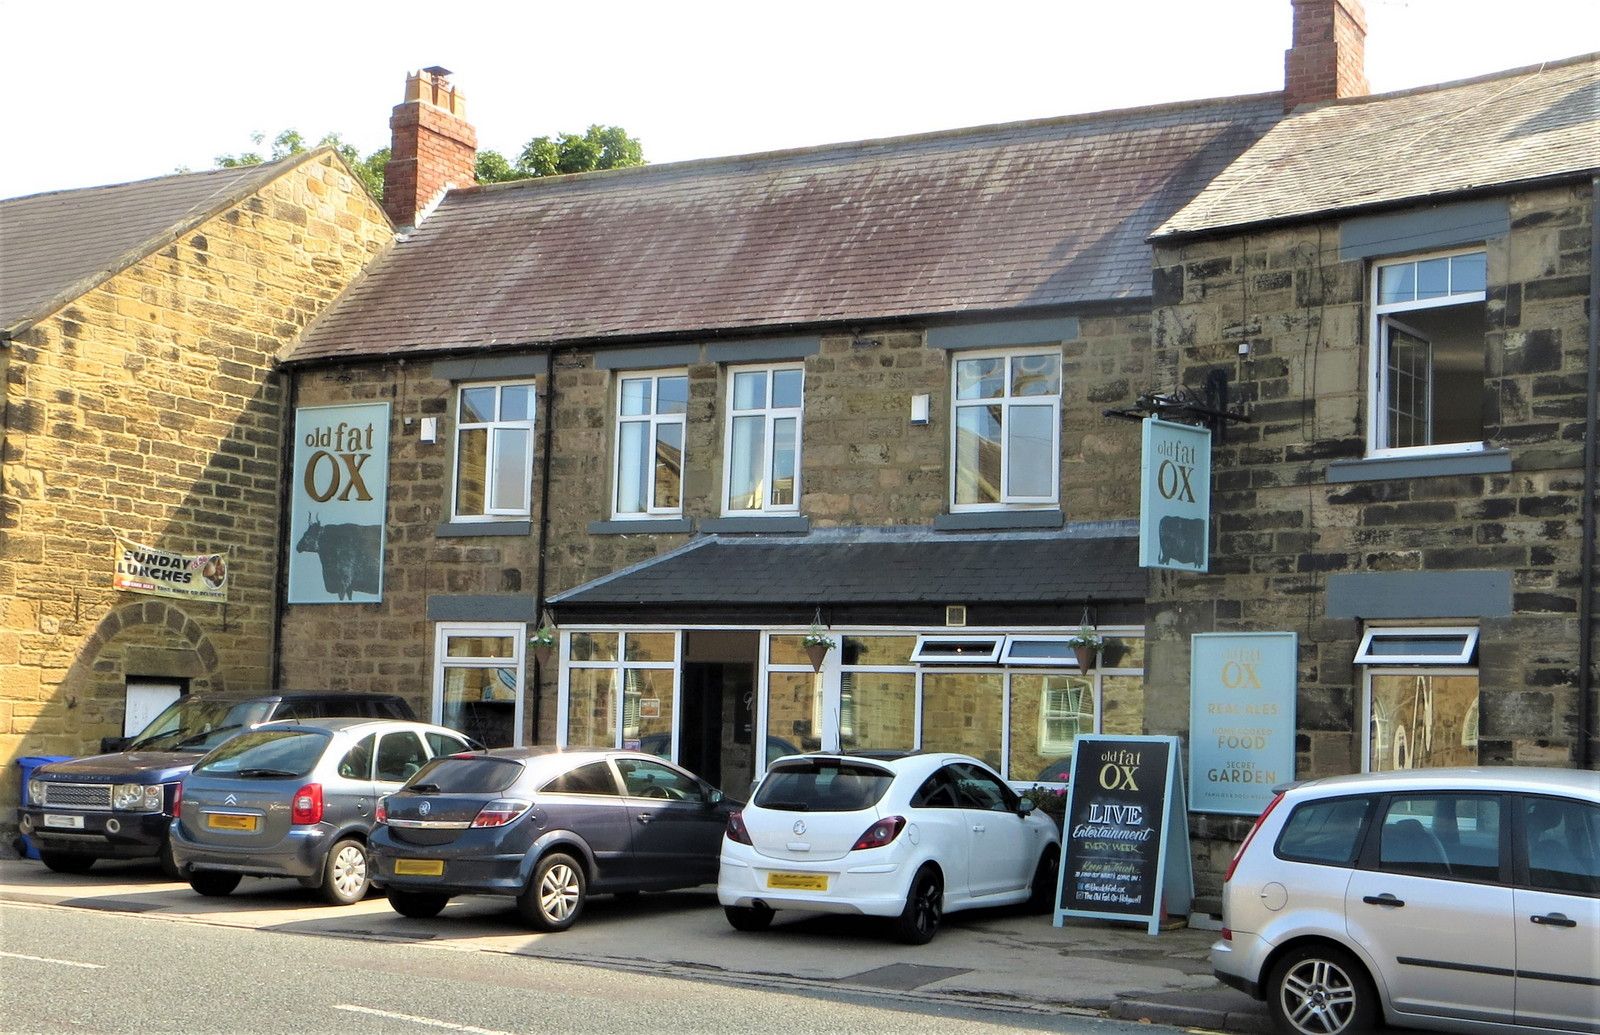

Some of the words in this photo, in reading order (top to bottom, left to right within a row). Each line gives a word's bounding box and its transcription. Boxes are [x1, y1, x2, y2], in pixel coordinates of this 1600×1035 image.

[305, 427, 332, 448] old
[335, 422, 374, 452] fat
[1157, 440, 1173, 456] old
[1174, 440, 1195, 464] fat
[304, 450, 374, 502] OX
[1157, 459, 1196, 503] OX
[124, 549, 192, 570] SUNDAY
[117, 561, 193, 584] LUNCHES
[1221, 660, 1262, 689] OX
[1217, 735, 1266, 750] FOOD
[1101, 751, 1117, 762] old
[1118, 750, 1141, 766] fat
[1226, 761, 1256, 769] SECRET
[1099, 763, 1140, 791] OX
[1207, 768, 1276, 784] GARDEN
[1088, 803, 1143, 825] LIVE
[1072, 823, 1155, 842] Entertainment
[1084, 841, 1111, 851] EVERY
